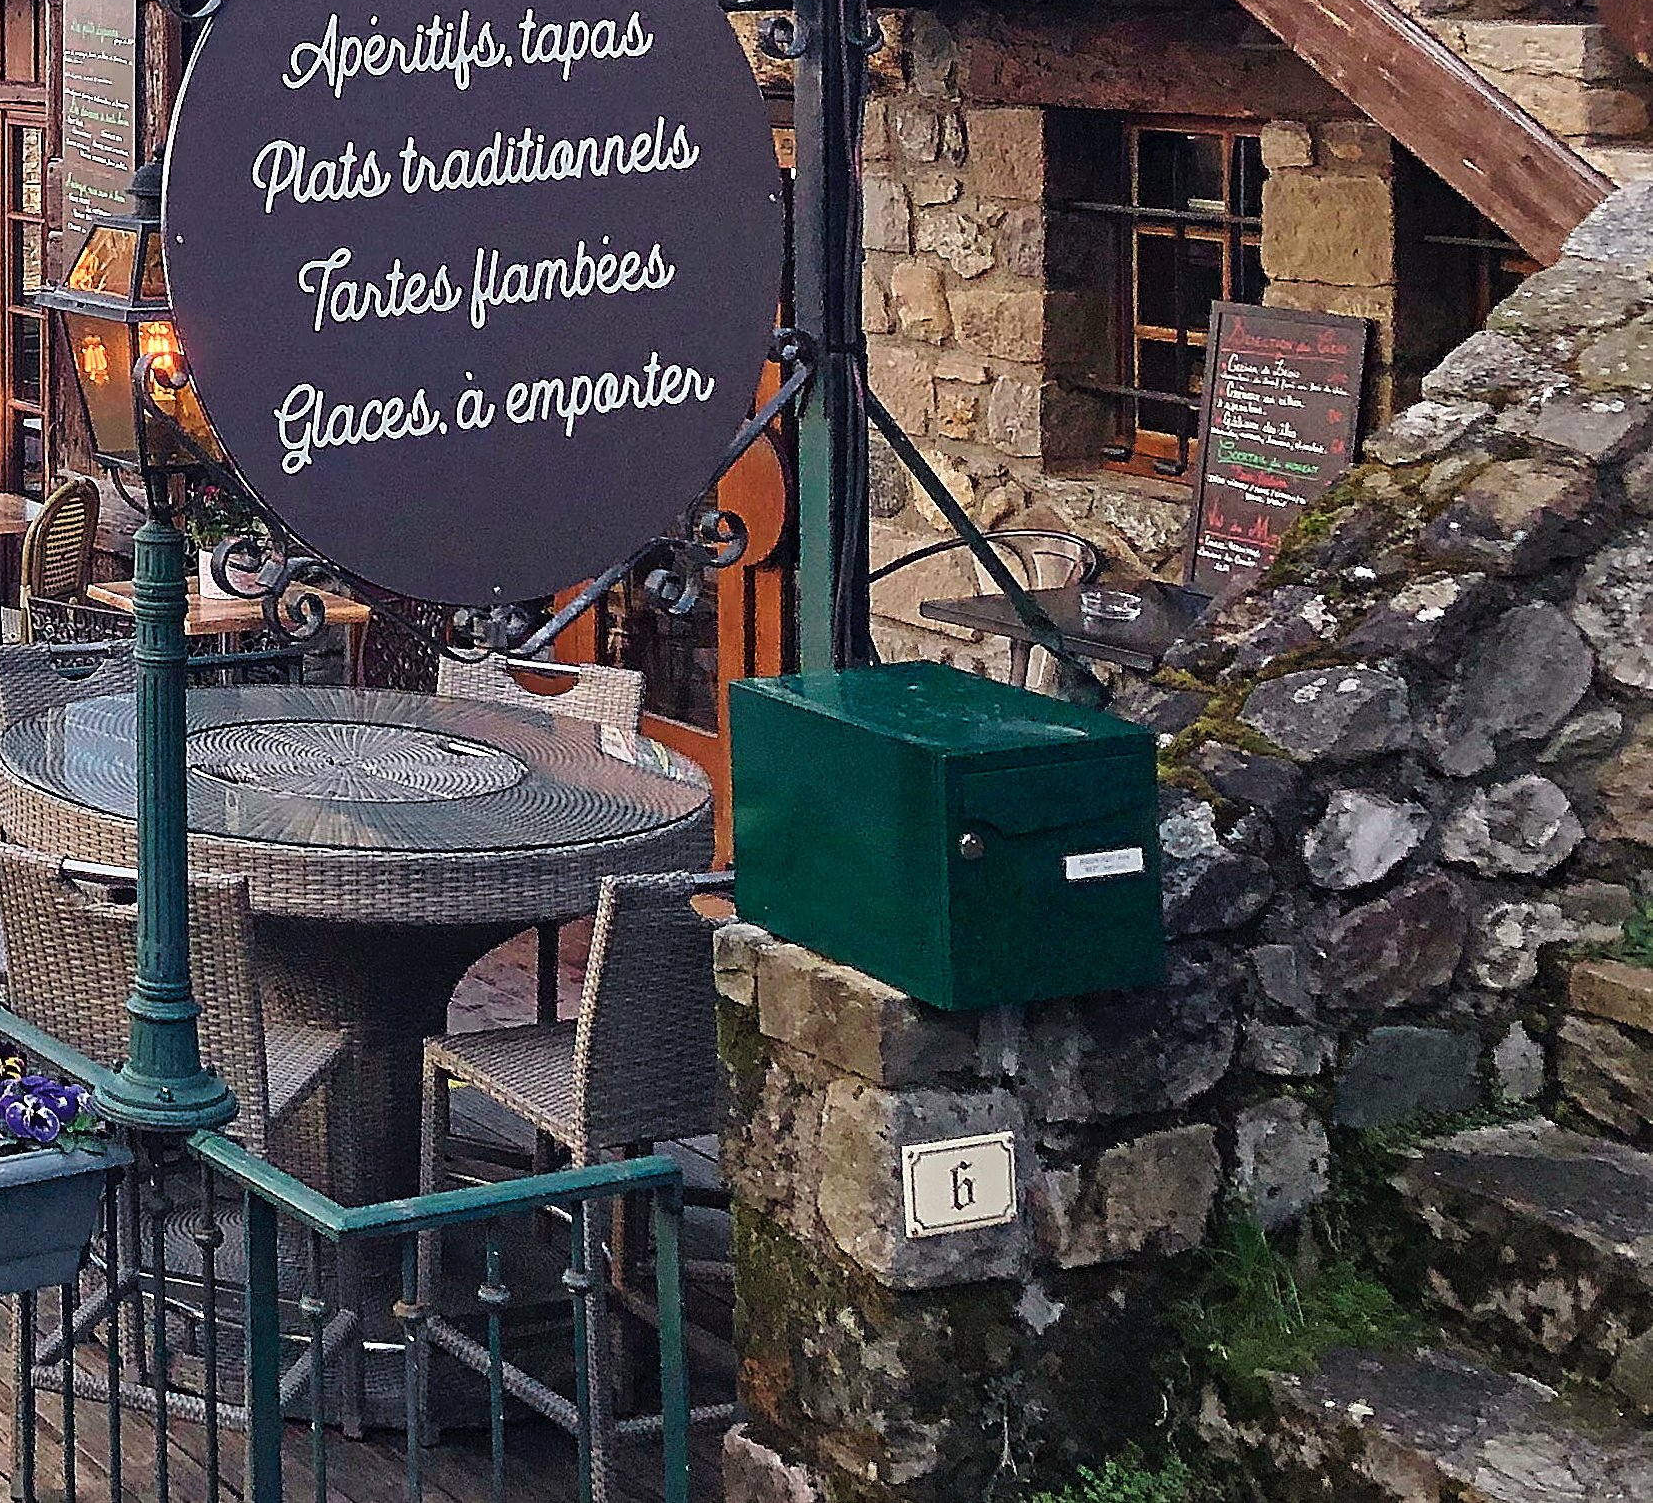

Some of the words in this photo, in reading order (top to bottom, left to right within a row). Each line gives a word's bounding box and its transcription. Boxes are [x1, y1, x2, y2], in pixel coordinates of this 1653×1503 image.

[518, 8, 654, 82] tapas
[252, 139, 392, 214] Plats
[398, 115, 700, 194] traditionnels
[298, 247, 463, 332] Tartes
[470, 234, 676, 330] flambées
[456, 371, 496, 430] à
[506, 351, 716, 438] emporter
[949, 1159, 977, 1212] 6
